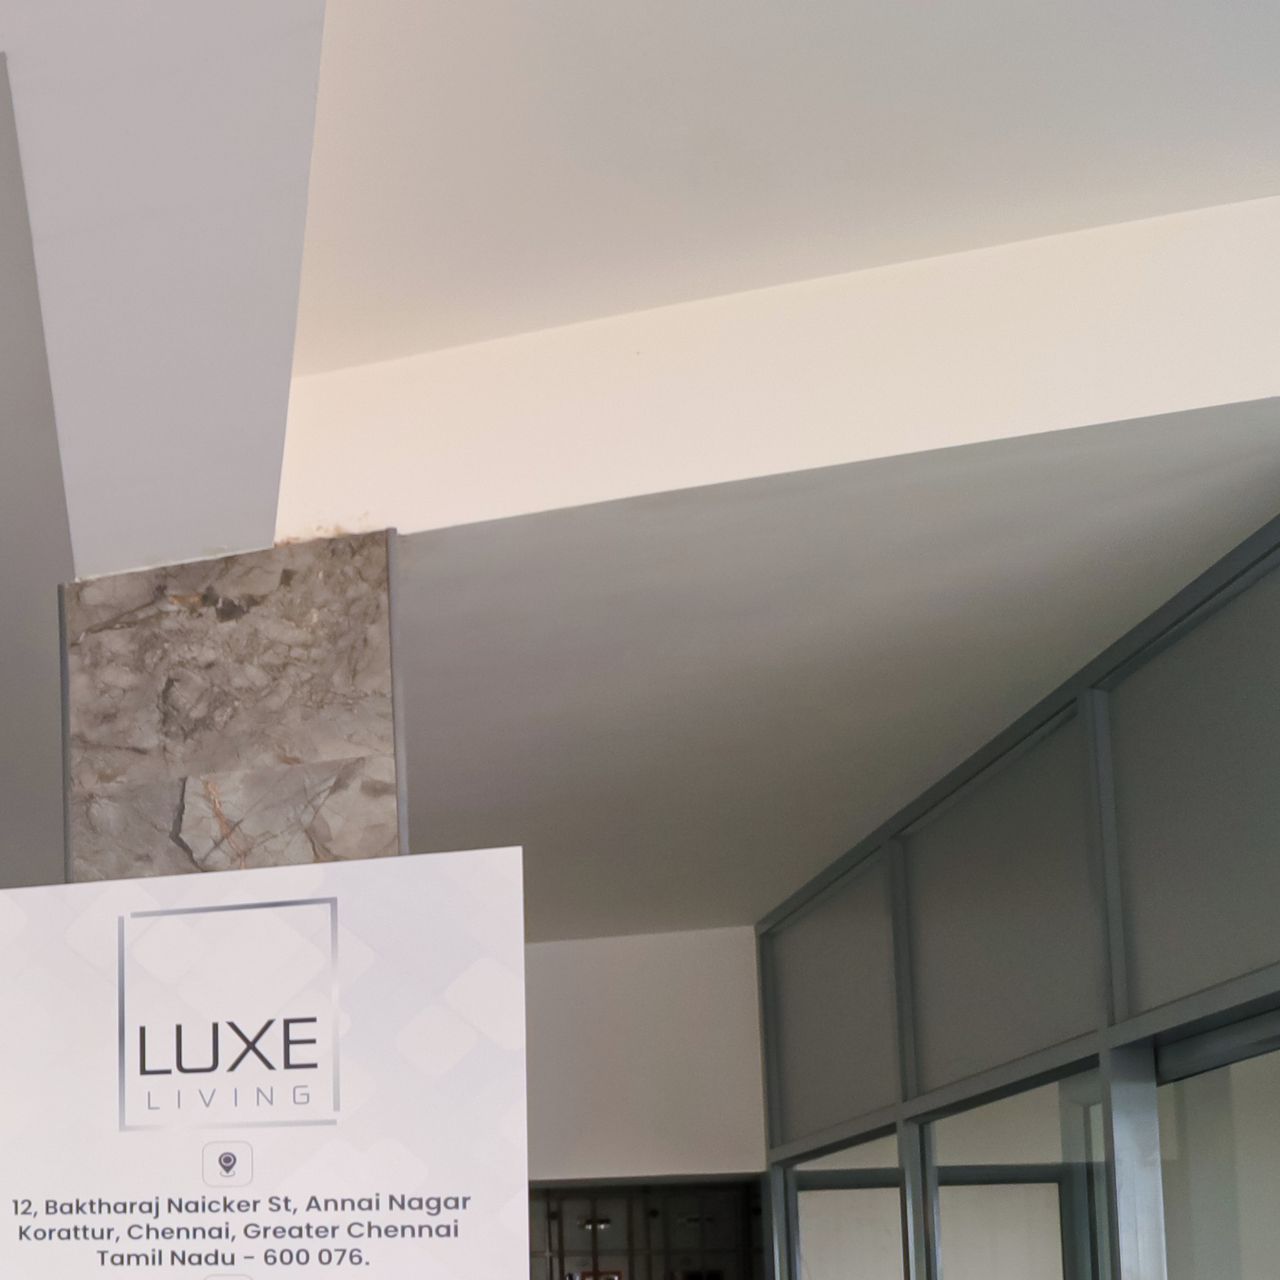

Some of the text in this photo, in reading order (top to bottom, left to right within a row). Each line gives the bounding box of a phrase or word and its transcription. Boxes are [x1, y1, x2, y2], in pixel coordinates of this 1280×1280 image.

[138, 1015, 319, 1077] LUXE
[147, 1084, 311, 1111] LIVING
[11, 1191, 472, 1220] 12, Baktharaj Naicker St, Annai Nagar
[18, 1218, 459, 1244] Korattur, Chennai, Greater Chennai
[96, 1247, 163, 1267] Tamil
[170, 1247, 236, 1267] Nadu
[263, 1247, 311, 1267] 600
[317, 1247, 371, 1267] 076.
